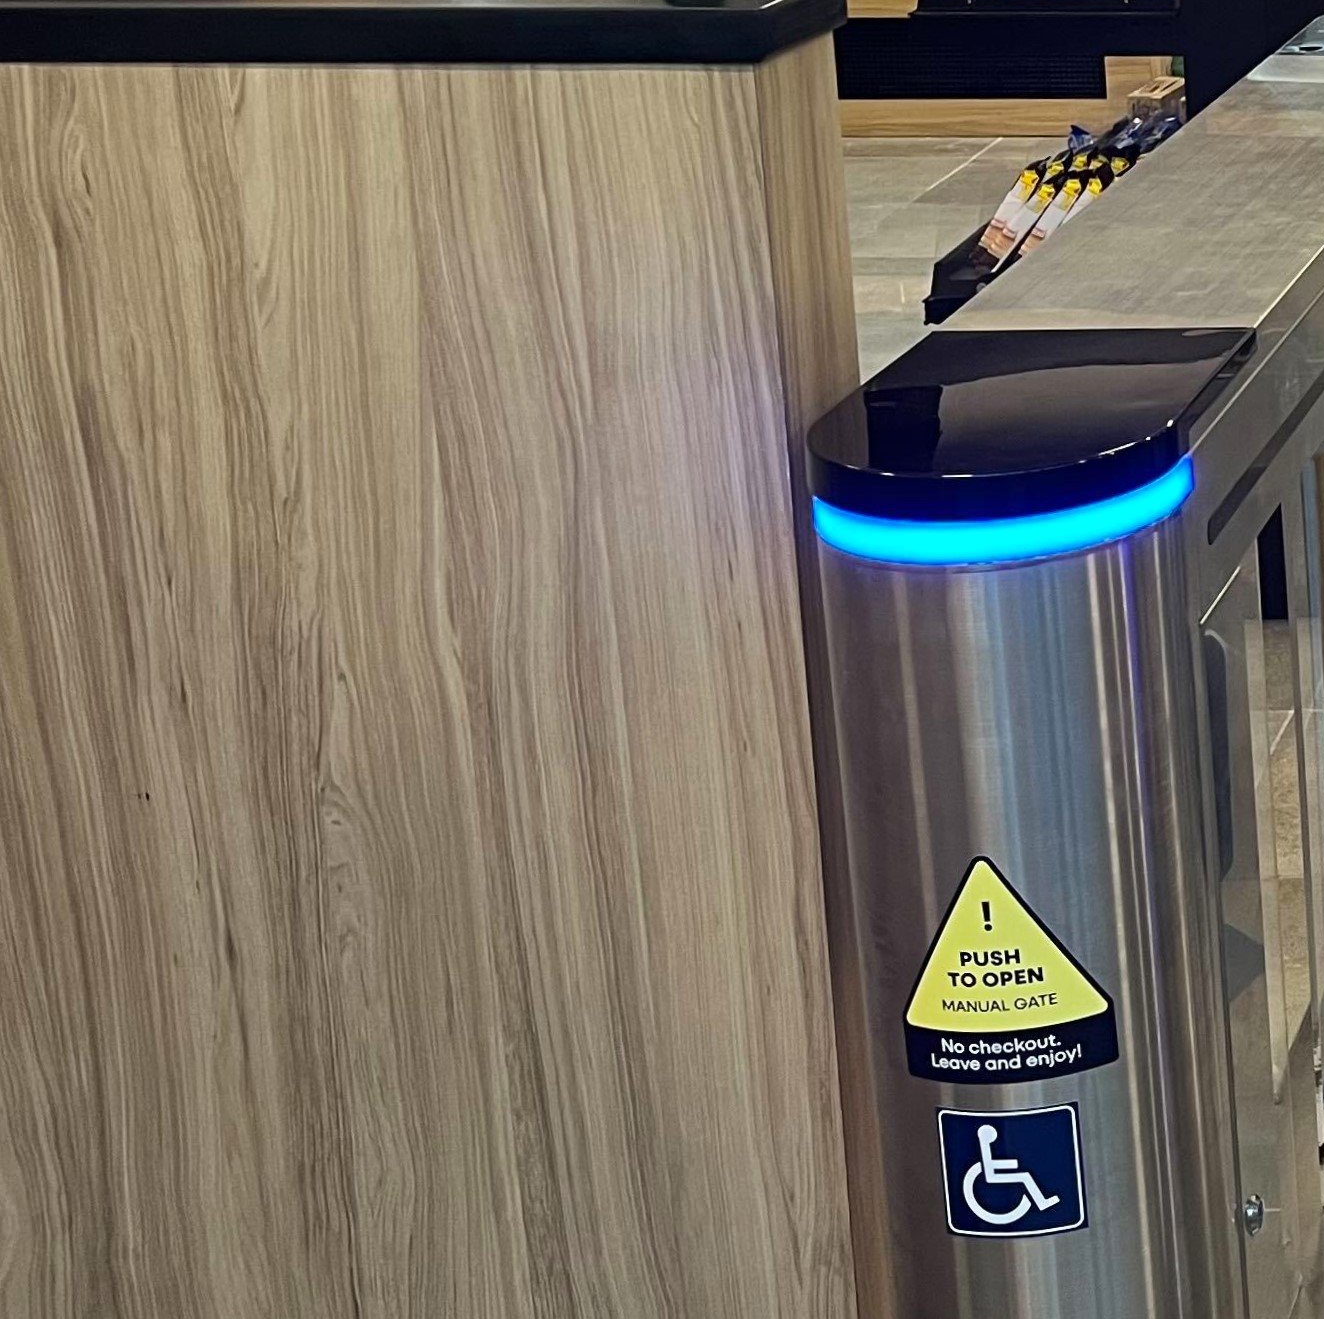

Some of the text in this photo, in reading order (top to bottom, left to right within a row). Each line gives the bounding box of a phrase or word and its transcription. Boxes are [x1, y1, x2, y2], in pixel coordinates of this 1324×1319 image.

[960, 949, 1020, 966] PUSH
[948, 967, 1044, 987] TO OPEN
[942, 993, 1058, 1012] MANUAL GATE
[941, 1034, 1061, 1054] No checkout.
[931, 1043, 1082, 1071] Leave and enjoy!
